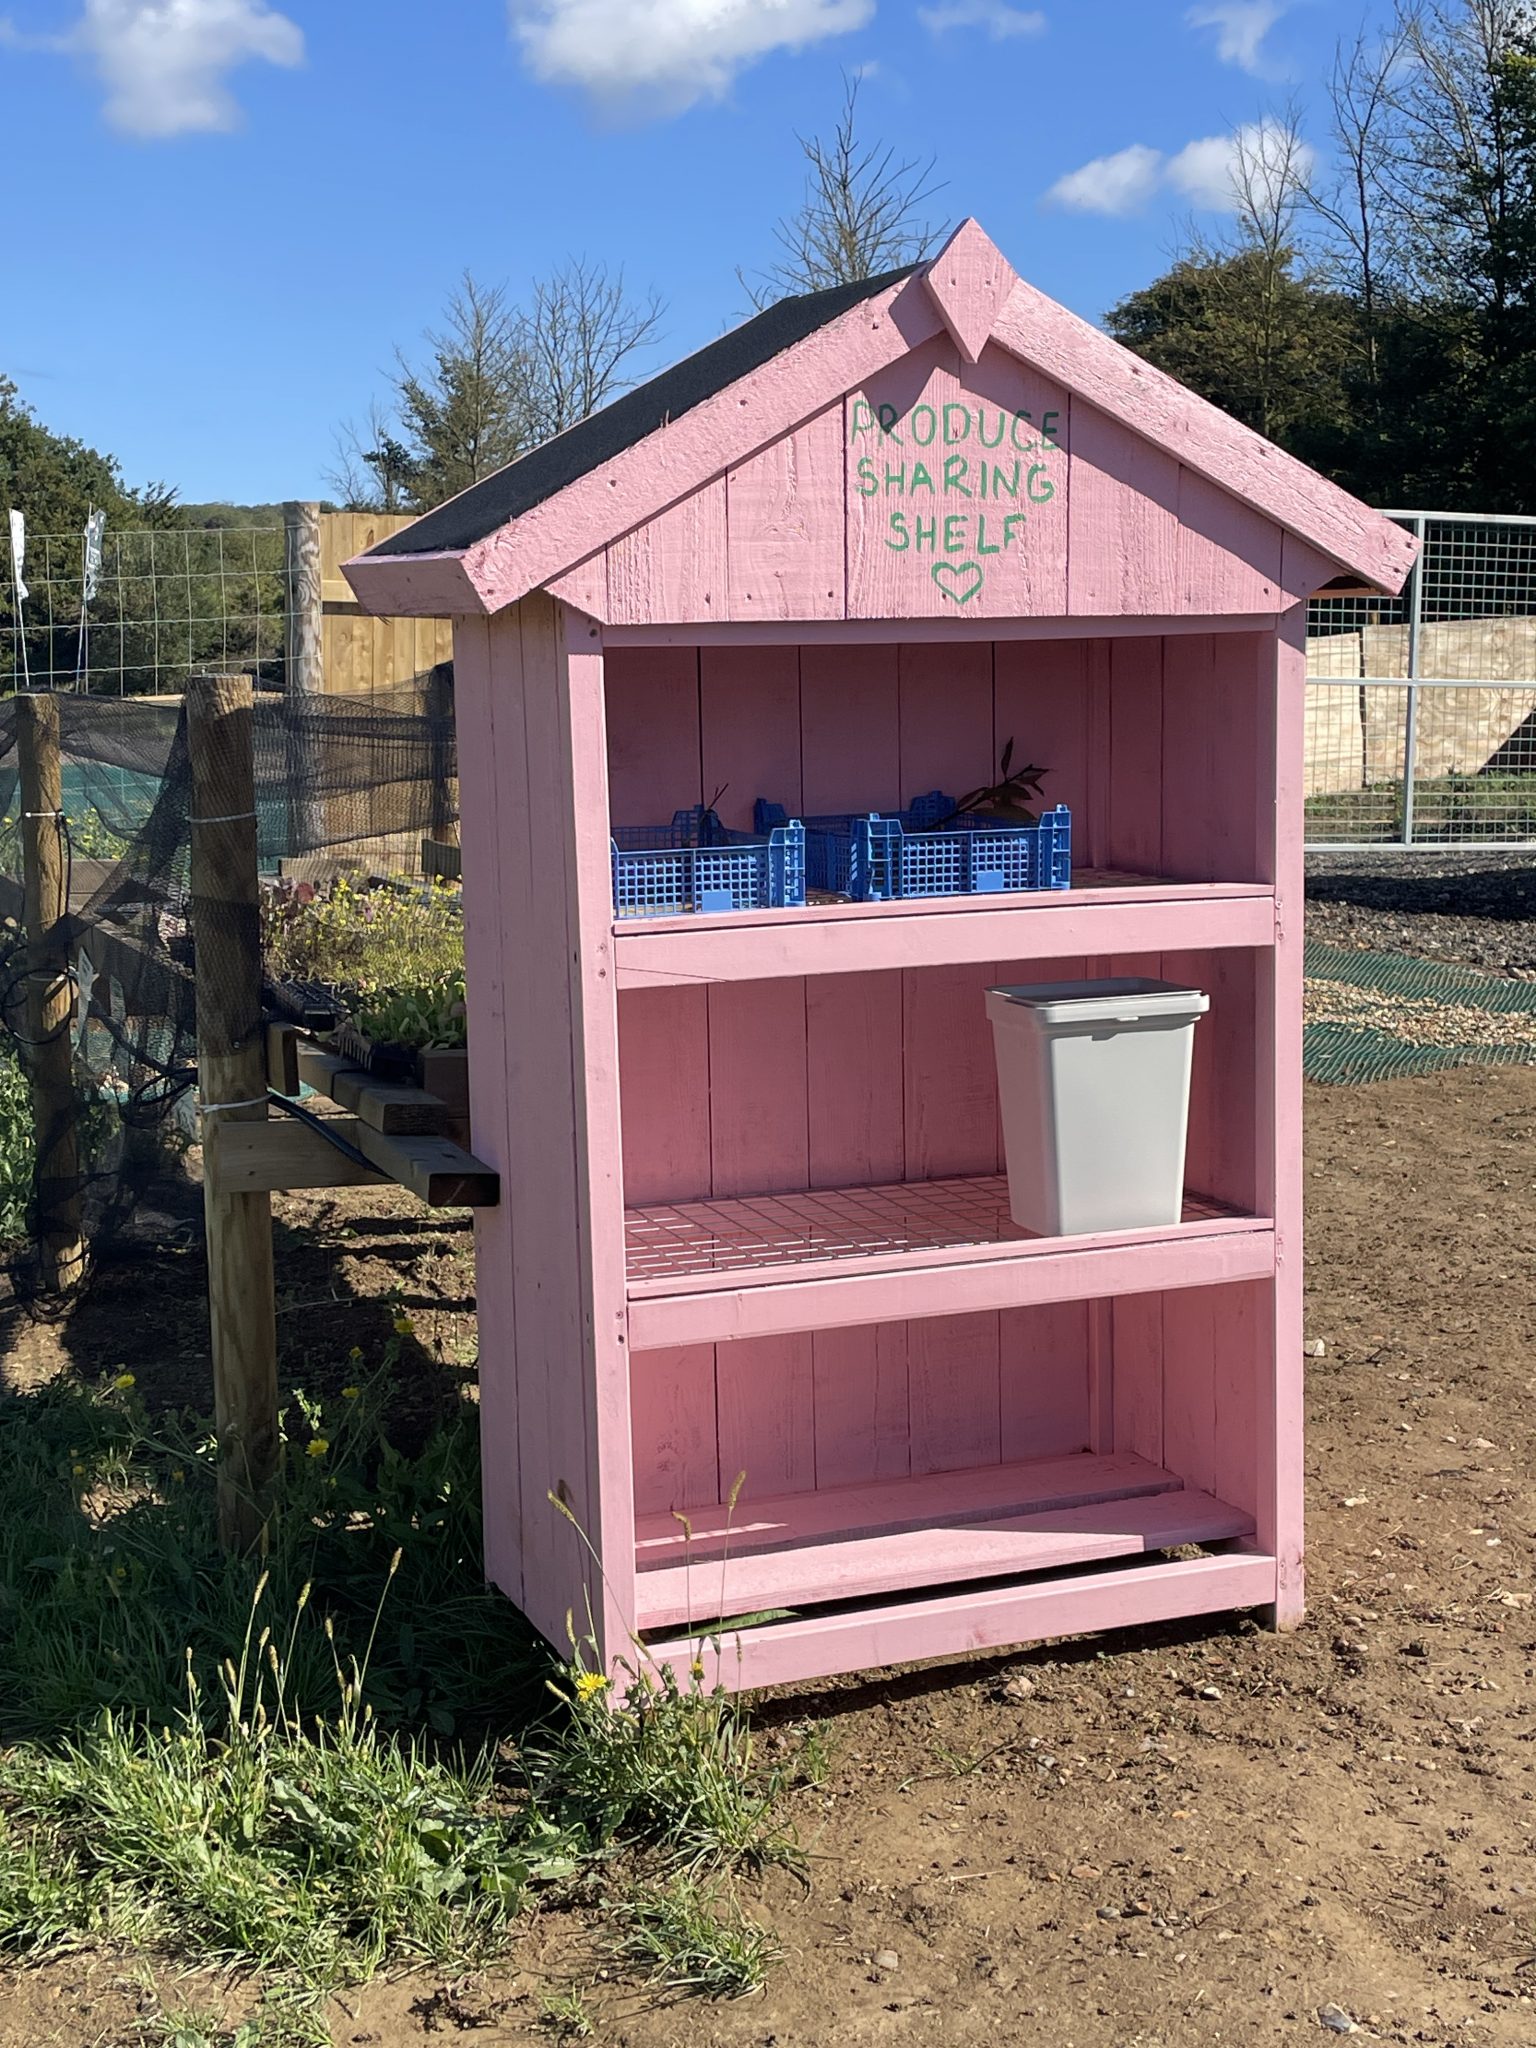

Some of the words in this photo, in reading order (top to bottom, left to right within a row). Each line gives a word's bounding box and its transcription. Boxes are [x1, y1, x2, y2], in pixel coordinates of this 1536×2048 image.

[851, 399, 1060, 451] PRODUCE
[856, 454, 1055, 503] SHARING
[884, 512, 1026, 555] SHELF
